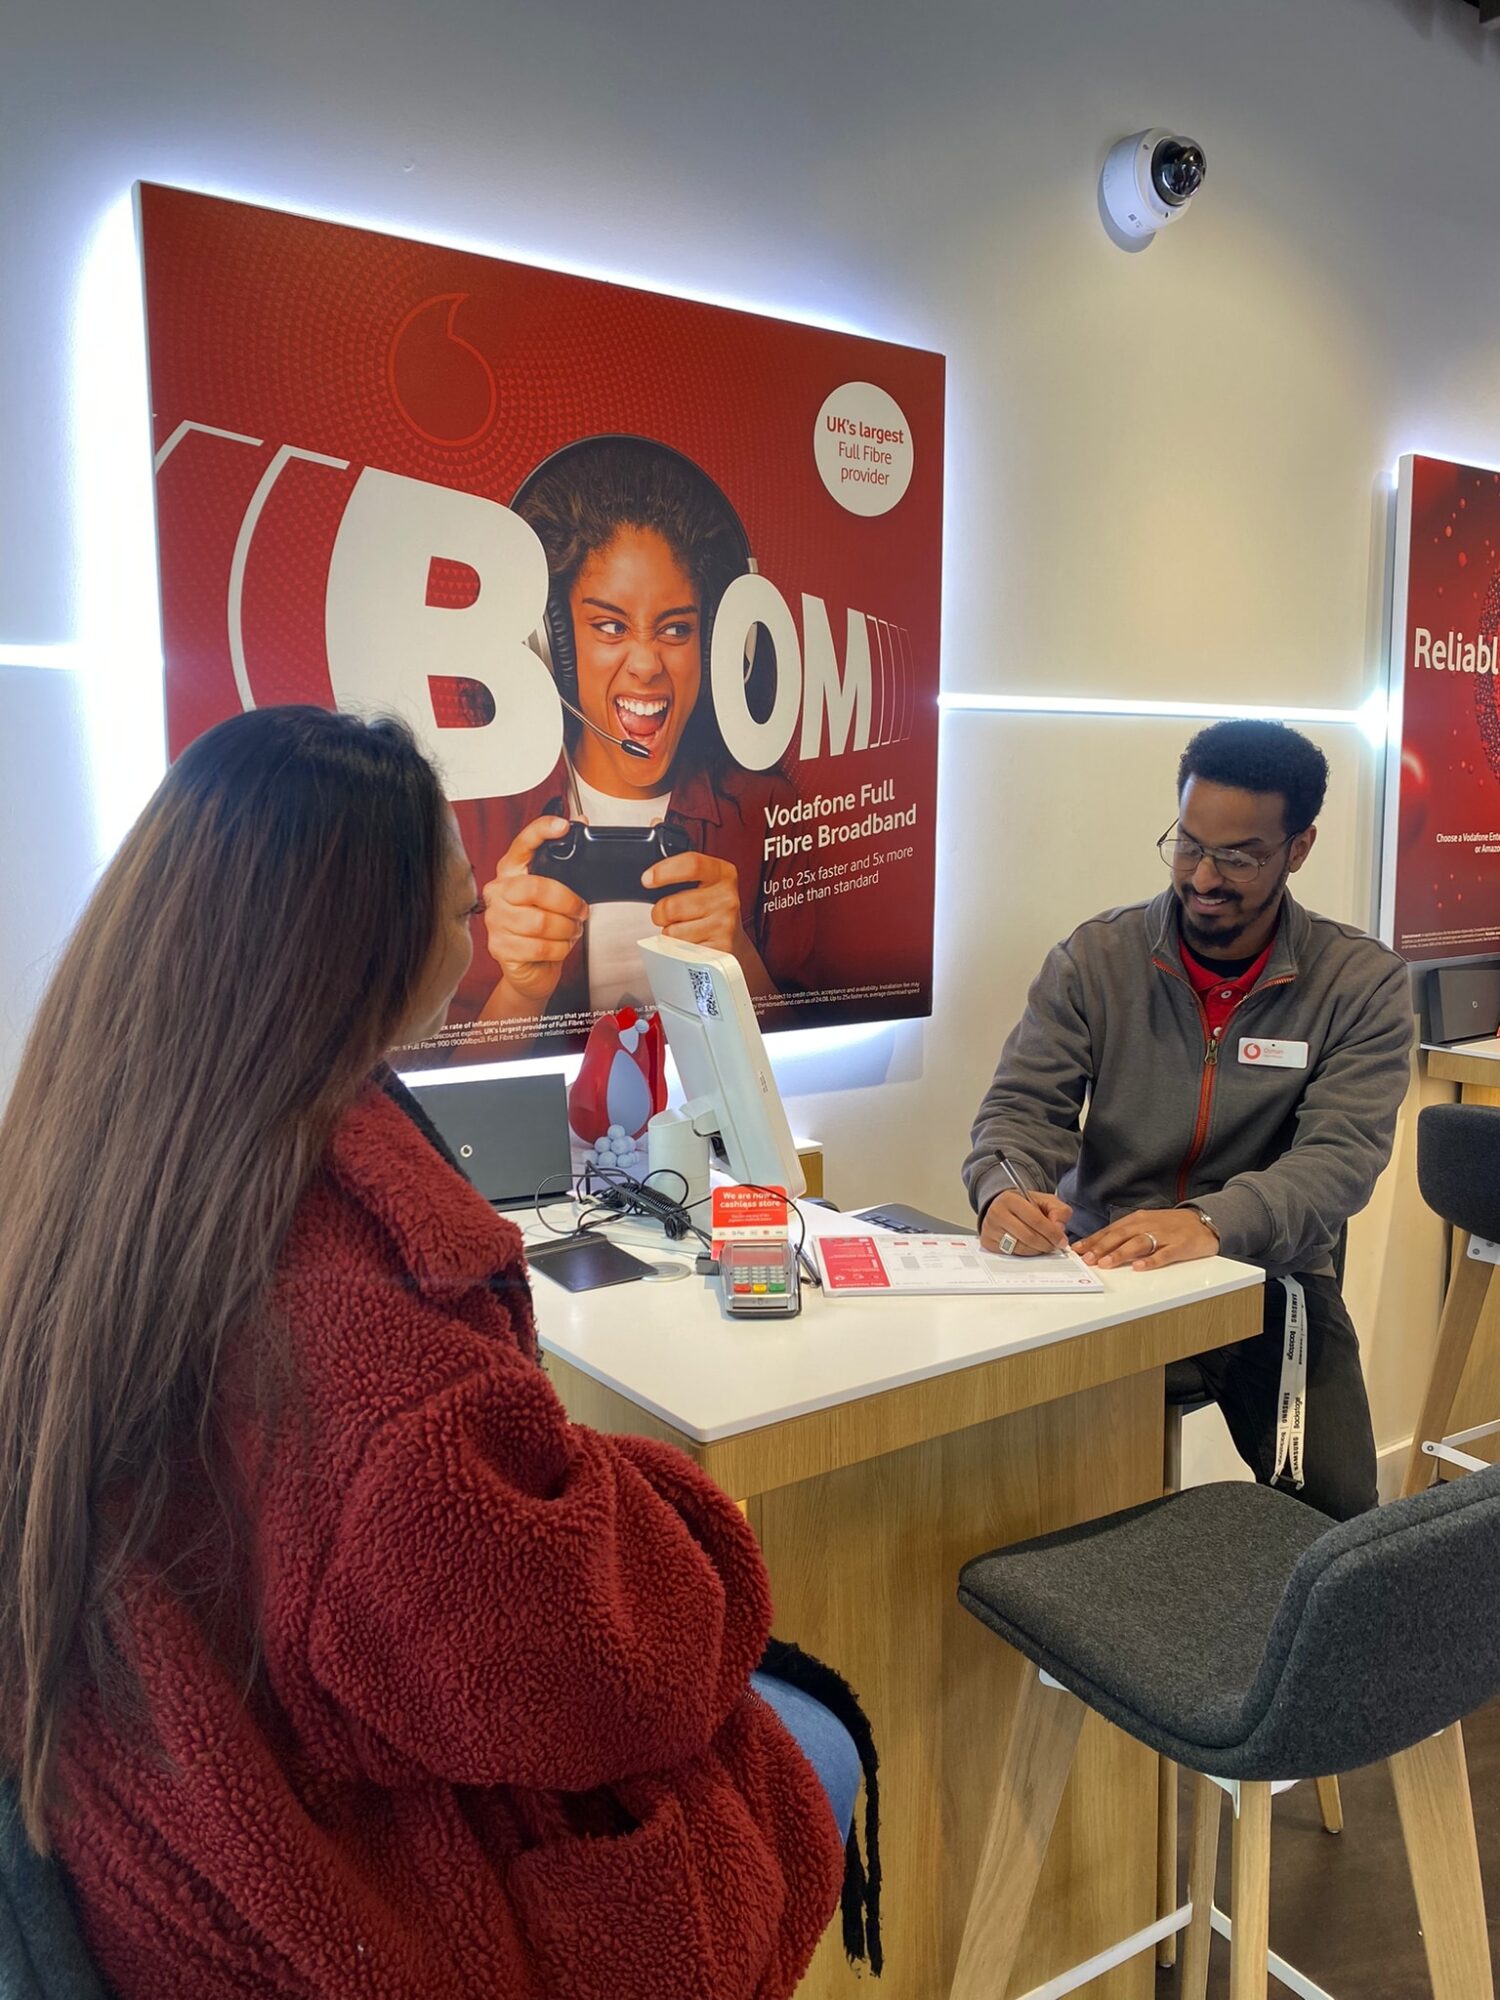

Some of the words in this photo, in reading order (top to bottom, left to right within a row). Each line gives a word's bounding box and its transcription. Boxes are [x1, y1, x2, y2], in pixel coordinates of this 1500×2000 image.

[826, 415, 856, 436] UK's
[860, 421, 904, 444] largest
[839, 441, 860, 461] Full
[863, 445, 892, 465] Fibre
[841, 467, 889, 485] provider
[325, 465, 873, 801] BOM
[1414, 627, 1499, 675] Reliabl
[764, 795, 855, 829] Vodafone
[860, 779, 896, 807] Full
[763, 833, 813, 861] Fibre
[818, 803, 917, 848] Broadband
[1436, 833, 1458, 843] Choose
[1462, 832, 1488, 842] Vodafone
[763, 880, 780, 896] Up
[782, 877, 794, 890] to
[796, 870, 816, 887] 25x
[818, 862, 849, 880] faster
[850, 856, 870, 872] and
[872, 853, 885, 867] 5x
[886, 846, 914, 863] more
[763, 892, 804, 914] reliable
[807, 885, 831, 902] than
[833, 871, 879, 895] standard
[472, 1019, 499, 1028] inflation
[500, 1016, 531, 1026] published
[540, 1013, 564, 1022] January
[522, 1022, 548, 1032] provider
[555, 1020, 568, 1028] Full
[720, 1200, 757, 1208] cashless
[723, 1191, 736, 1200] We
[1290, 1293, 1298, 1323] SAMSUNG
[1287, 1330, 1296, 1361] Backstage
[1281, 1392, 1290, 1423] SAMSUNG
[1293, 1397, 1302, 1429] Backstage
